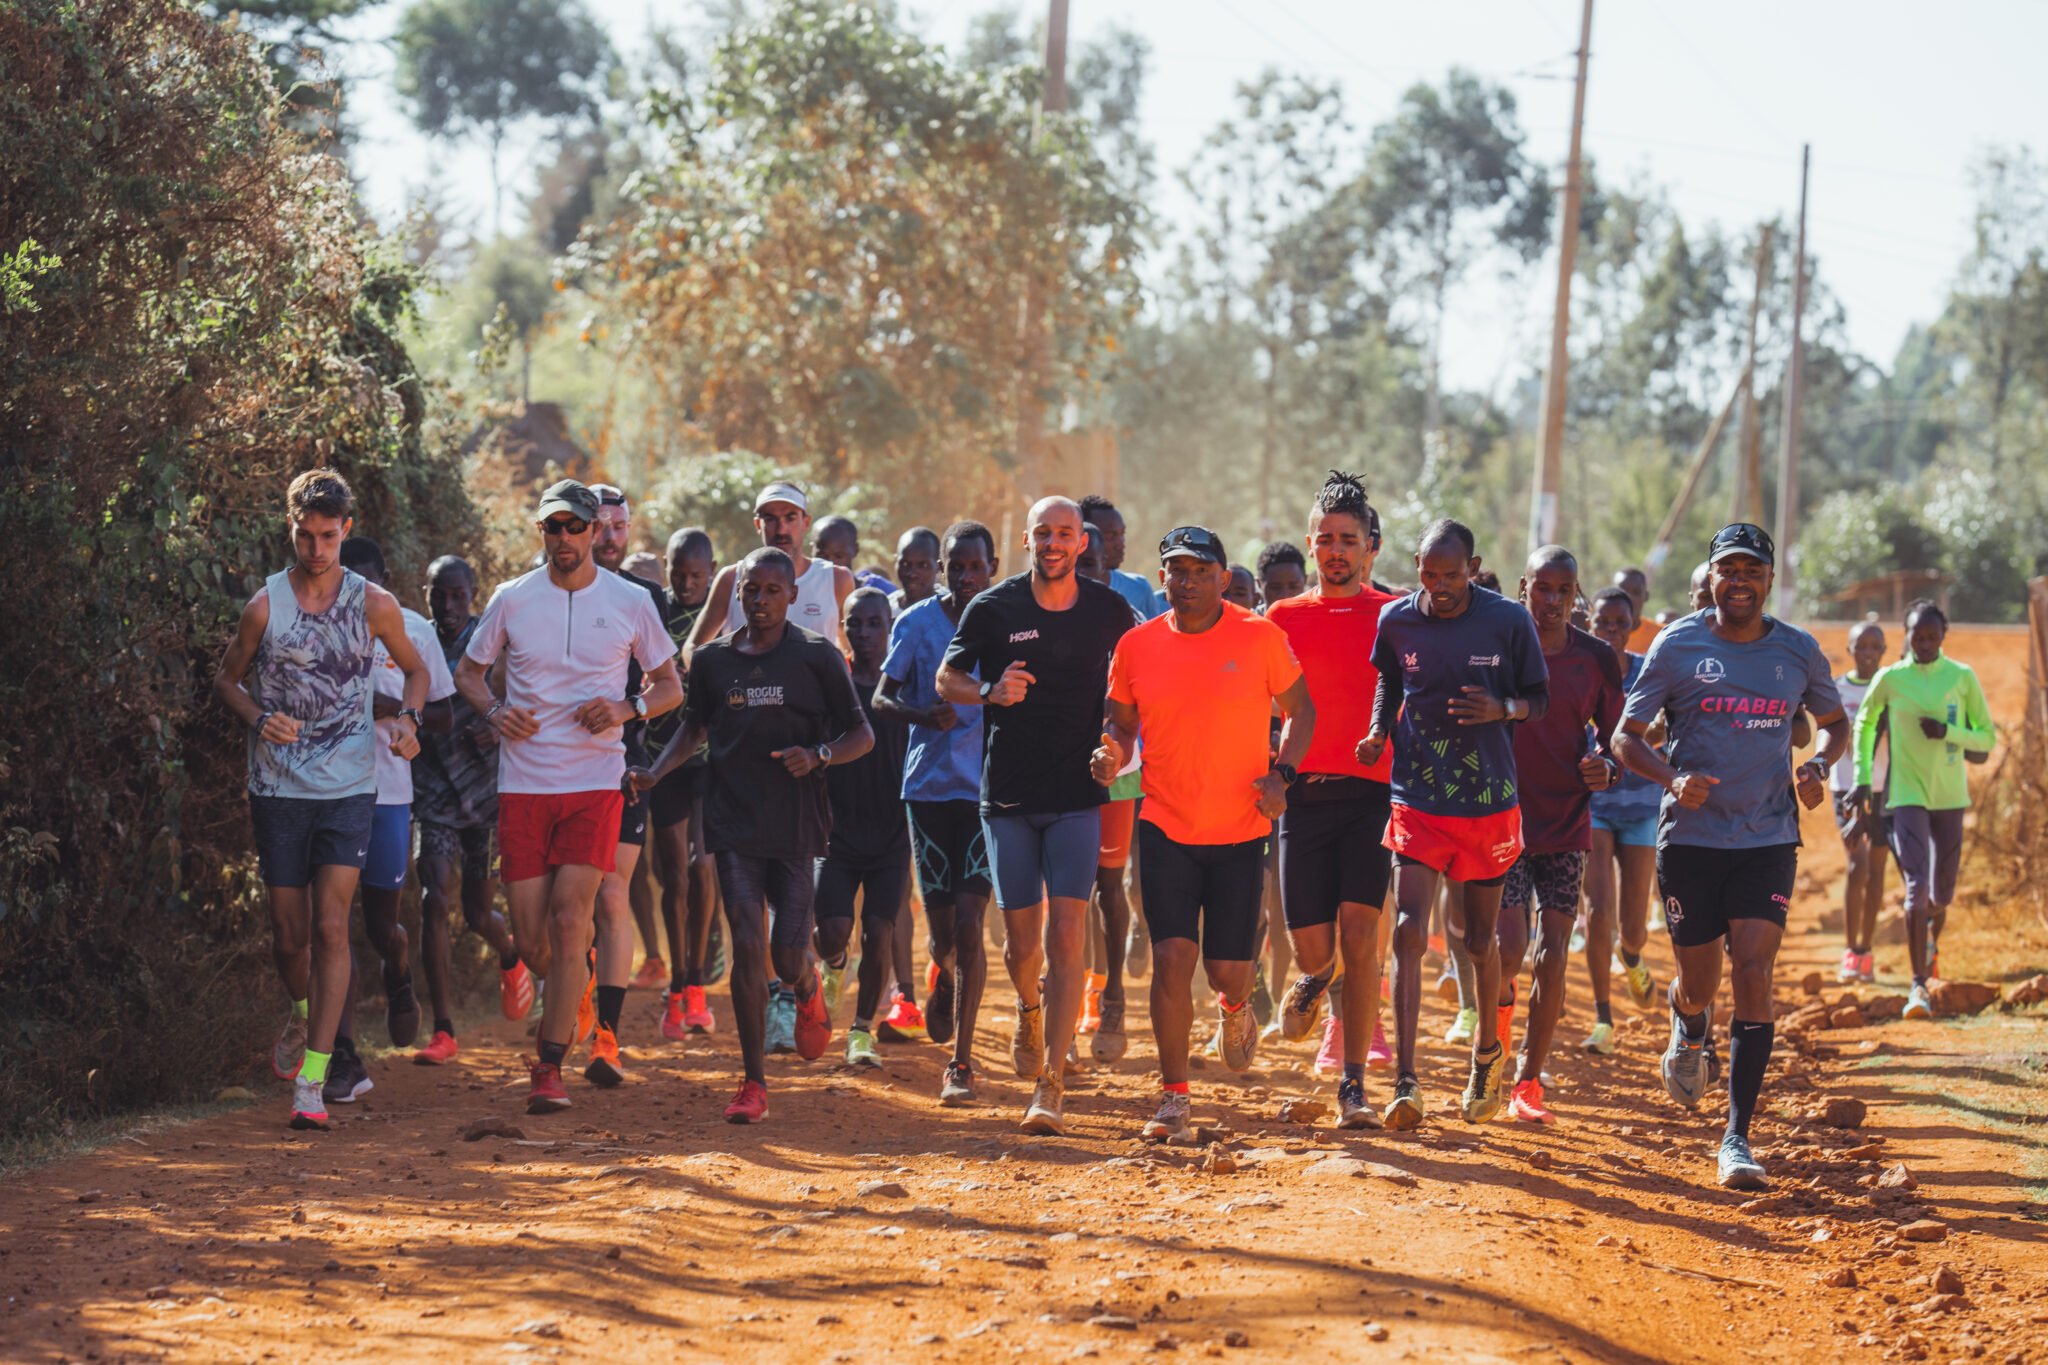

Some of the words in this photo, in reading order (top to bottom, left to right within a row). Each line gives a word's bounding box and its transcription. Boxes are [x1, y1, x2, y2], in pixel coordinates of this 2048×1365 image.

[1009, 629, 1040, 643] HOKA
[1704, 657, 1715, 673] F
[747, 686, 784, 698] ROGUE
[747, 696, 784, 707] RUNNING
[1700, 697, 1788, 716] CITABEL
[1745, 718, 1782, 729] SPORTS
